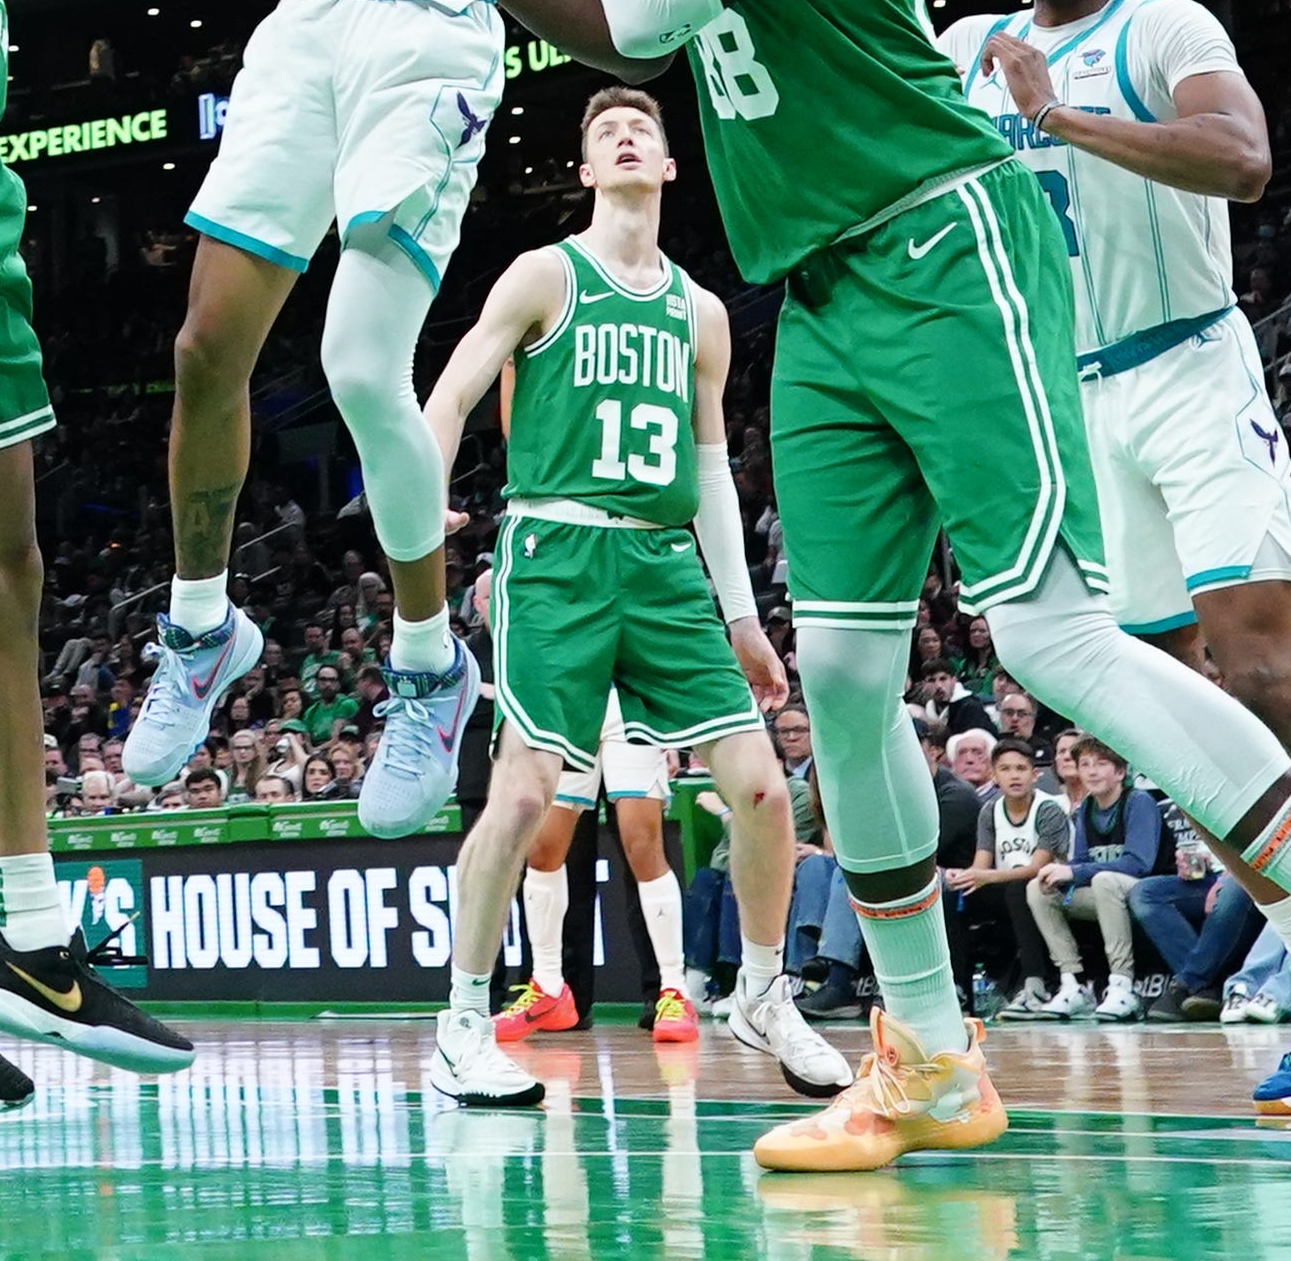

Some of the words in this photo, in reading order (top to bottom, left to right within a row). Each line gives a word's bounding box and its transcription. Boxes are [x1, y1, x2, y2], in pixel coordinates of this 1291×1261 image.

[573, 322, 691, 404] BOSTON
[591, 398, 679, 487] 13
[150, 870, 320, 970] HOUSE
[327, 867, 399, 969] OF
